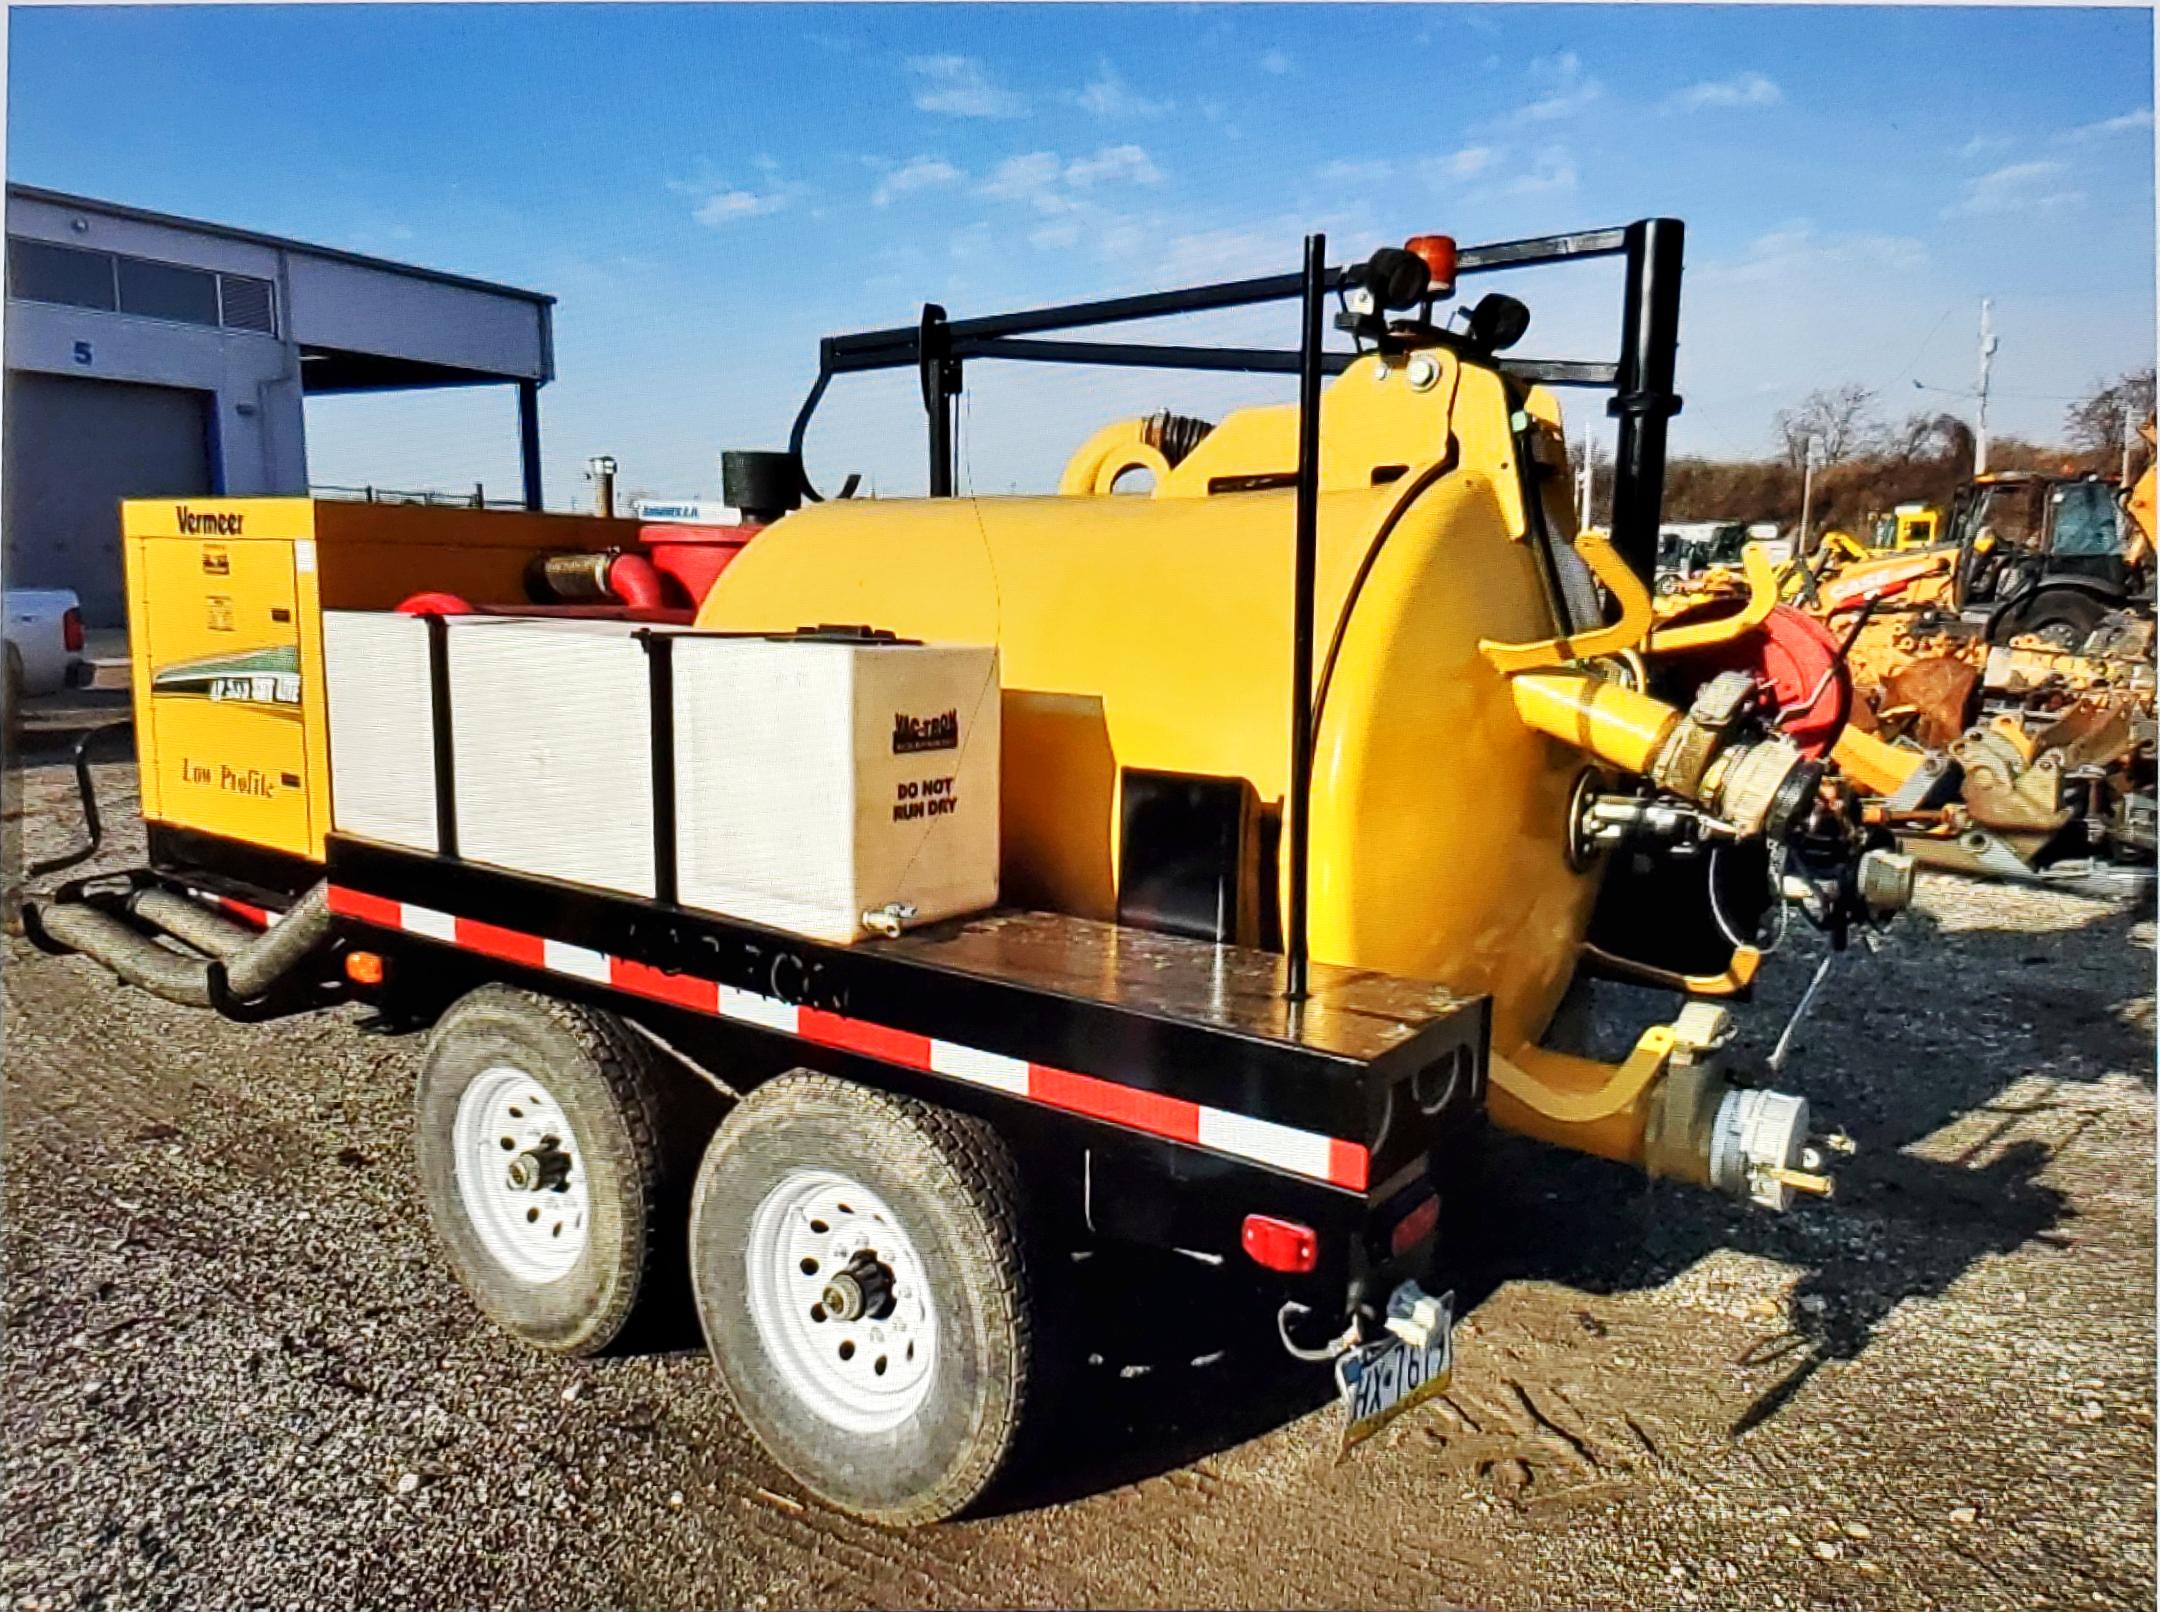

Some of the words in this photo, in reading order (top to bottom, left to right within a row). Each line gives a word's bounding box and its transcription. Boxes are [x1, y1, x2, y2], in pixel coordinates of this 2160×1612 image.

[74, 341, 93, 366] 5
[176, 505, 244, 536] Vermeer
[183, 757, 211, 785] Low
[220, 765, 274, 798] Profile
[897, 782, 918, 800] DO
[922, 777, 954, 796] NOT
[893, 801, 924, 822] RUN
[928, 797, 957, 815] DRY
